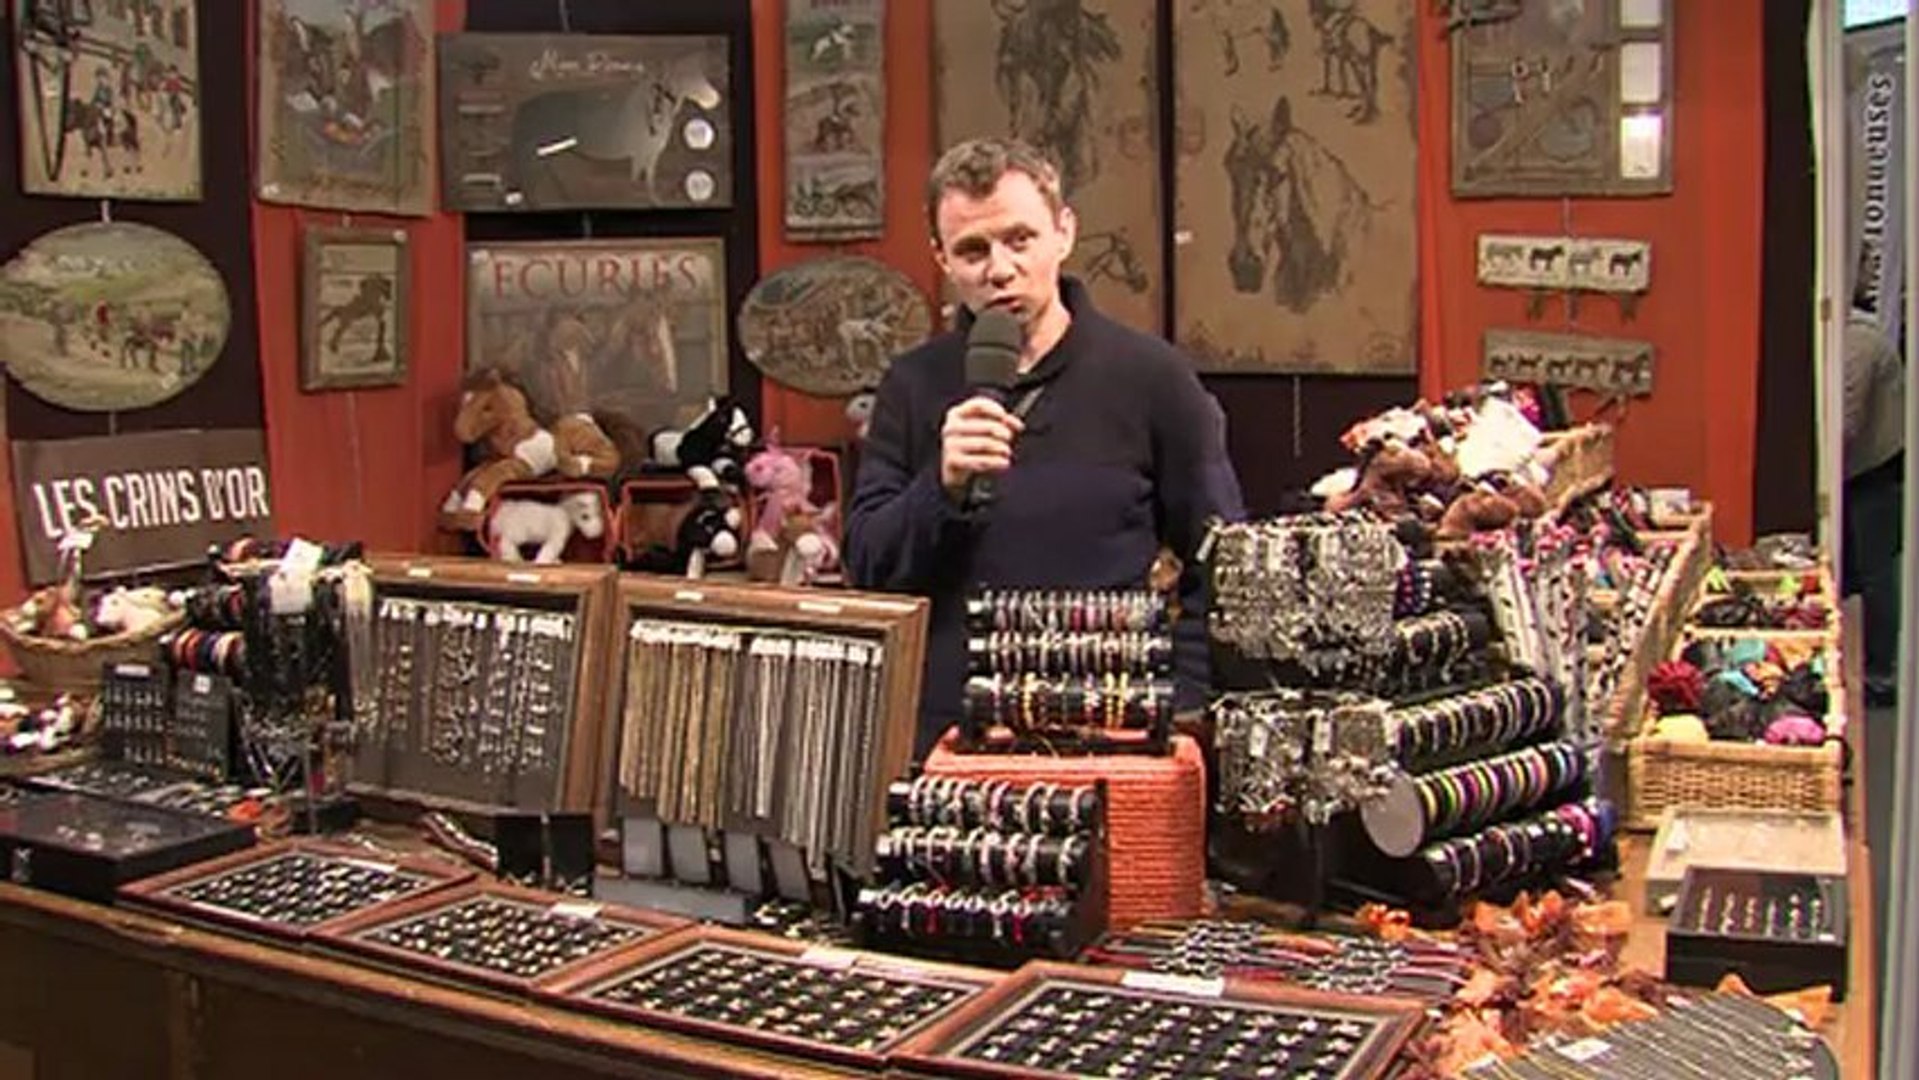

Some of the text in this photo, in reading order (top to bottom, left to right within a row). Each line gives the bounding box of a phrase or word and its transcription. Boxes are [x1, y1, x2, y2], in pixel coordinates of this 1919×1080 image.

[33, 466, 270, 539] LES CRINS D'OR
